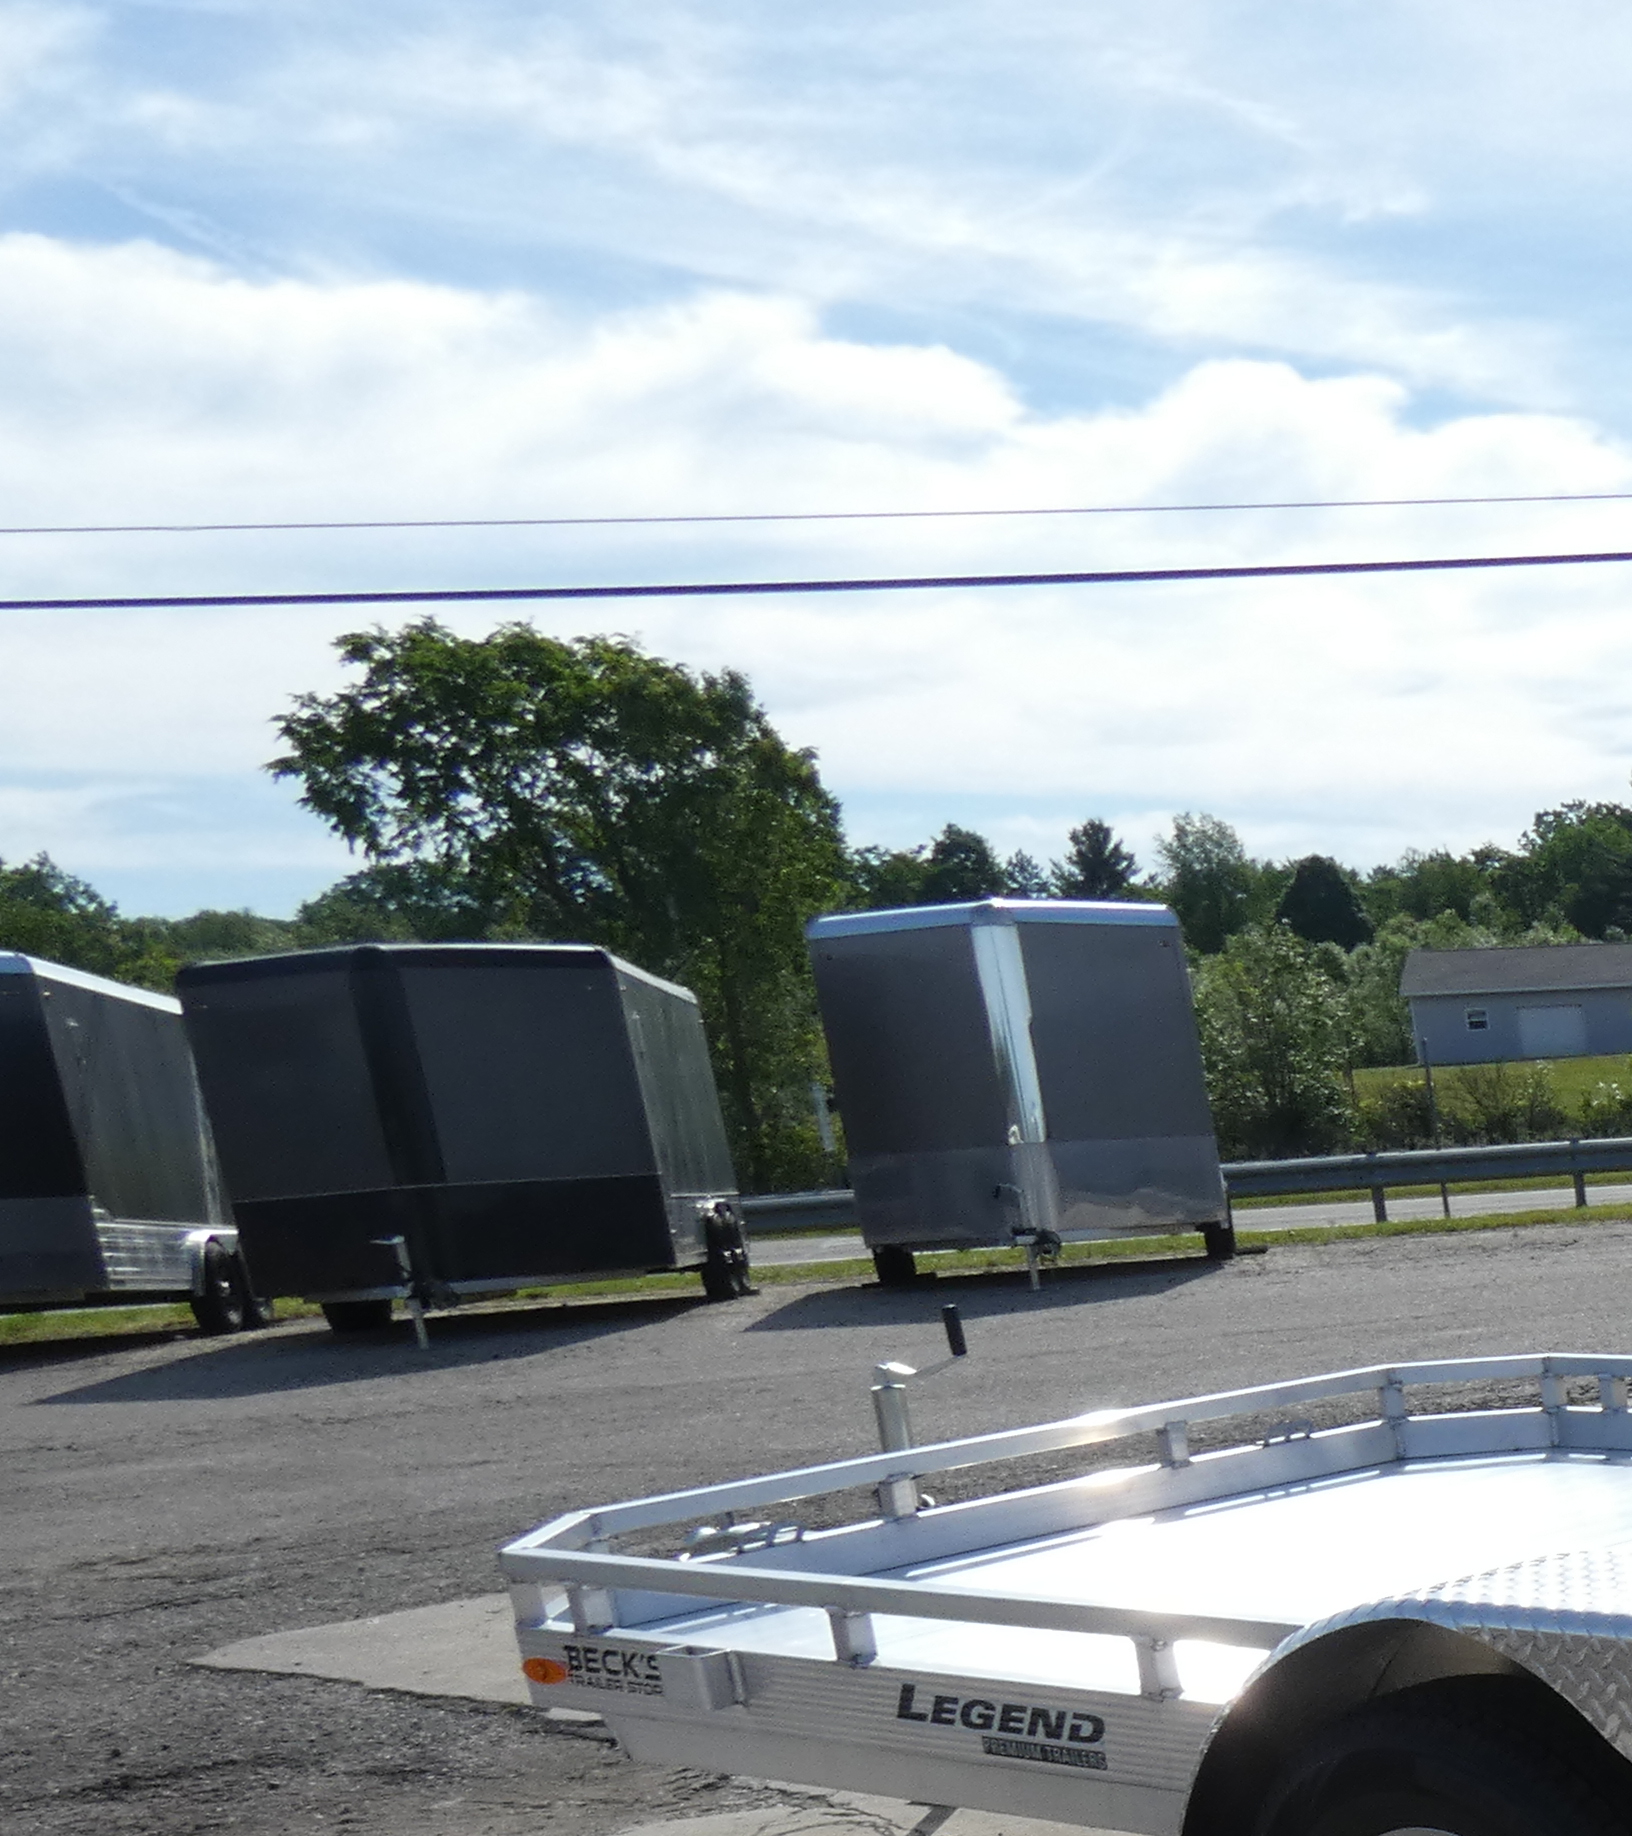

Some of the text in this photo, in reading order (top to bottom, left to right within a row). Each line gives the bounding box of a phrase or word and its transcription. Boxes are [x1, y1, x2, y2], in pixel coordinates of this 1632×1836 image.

[563, 1645, 662, 1680] BECK'S
[897, 1683, 1105, 1744] LEGEND
[1044, 1745, 1108, 1770] TRAILERS
